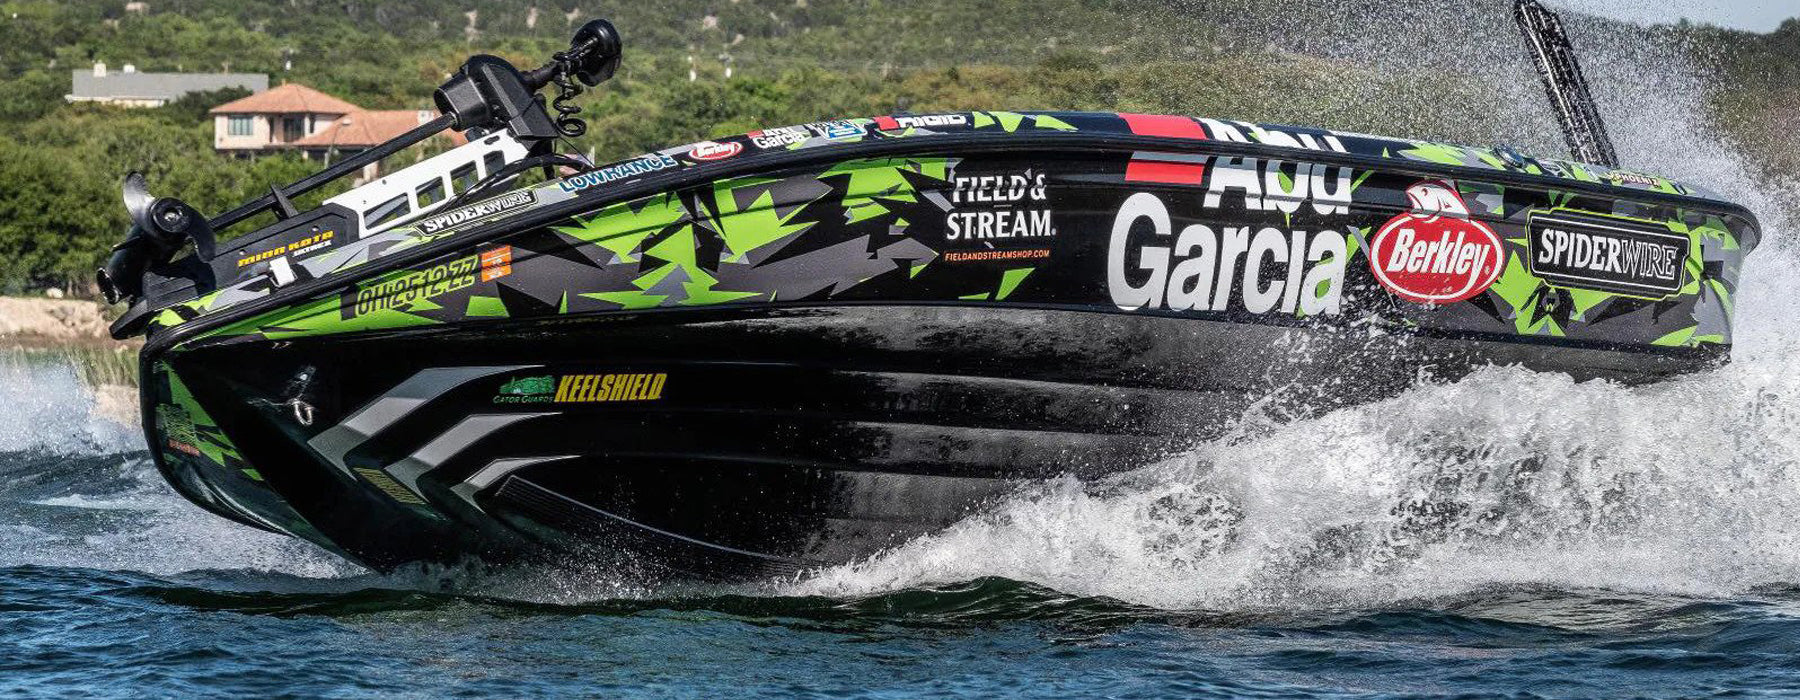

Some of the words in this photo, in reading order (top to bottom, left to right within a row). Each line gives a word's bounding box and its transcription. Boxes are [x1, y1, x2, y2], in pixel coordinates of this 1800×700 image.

[752, 131, 804, 149] Garcia
[559, 154, 679, 193] LOWRANCE
[952, 175, 1028, 203] FIELD
[1030, 173, 1047, 200] &
[423, 189, 532, 232] SPIDERWIRE
[946, 209, 1052, 240] STREAM
[945, 249, 1050, 262] FIELDANDSTREAMSHOP.COM
[1108, 192, 1348, 318] Garcia
[1386, 228, 1490, 287] Berkley
[1538, 228, 1679, 280] SPIDERWIRE
[493, 395, 520, 404] GATOR
[554, 373, 667, 402] KEELSHIELD
